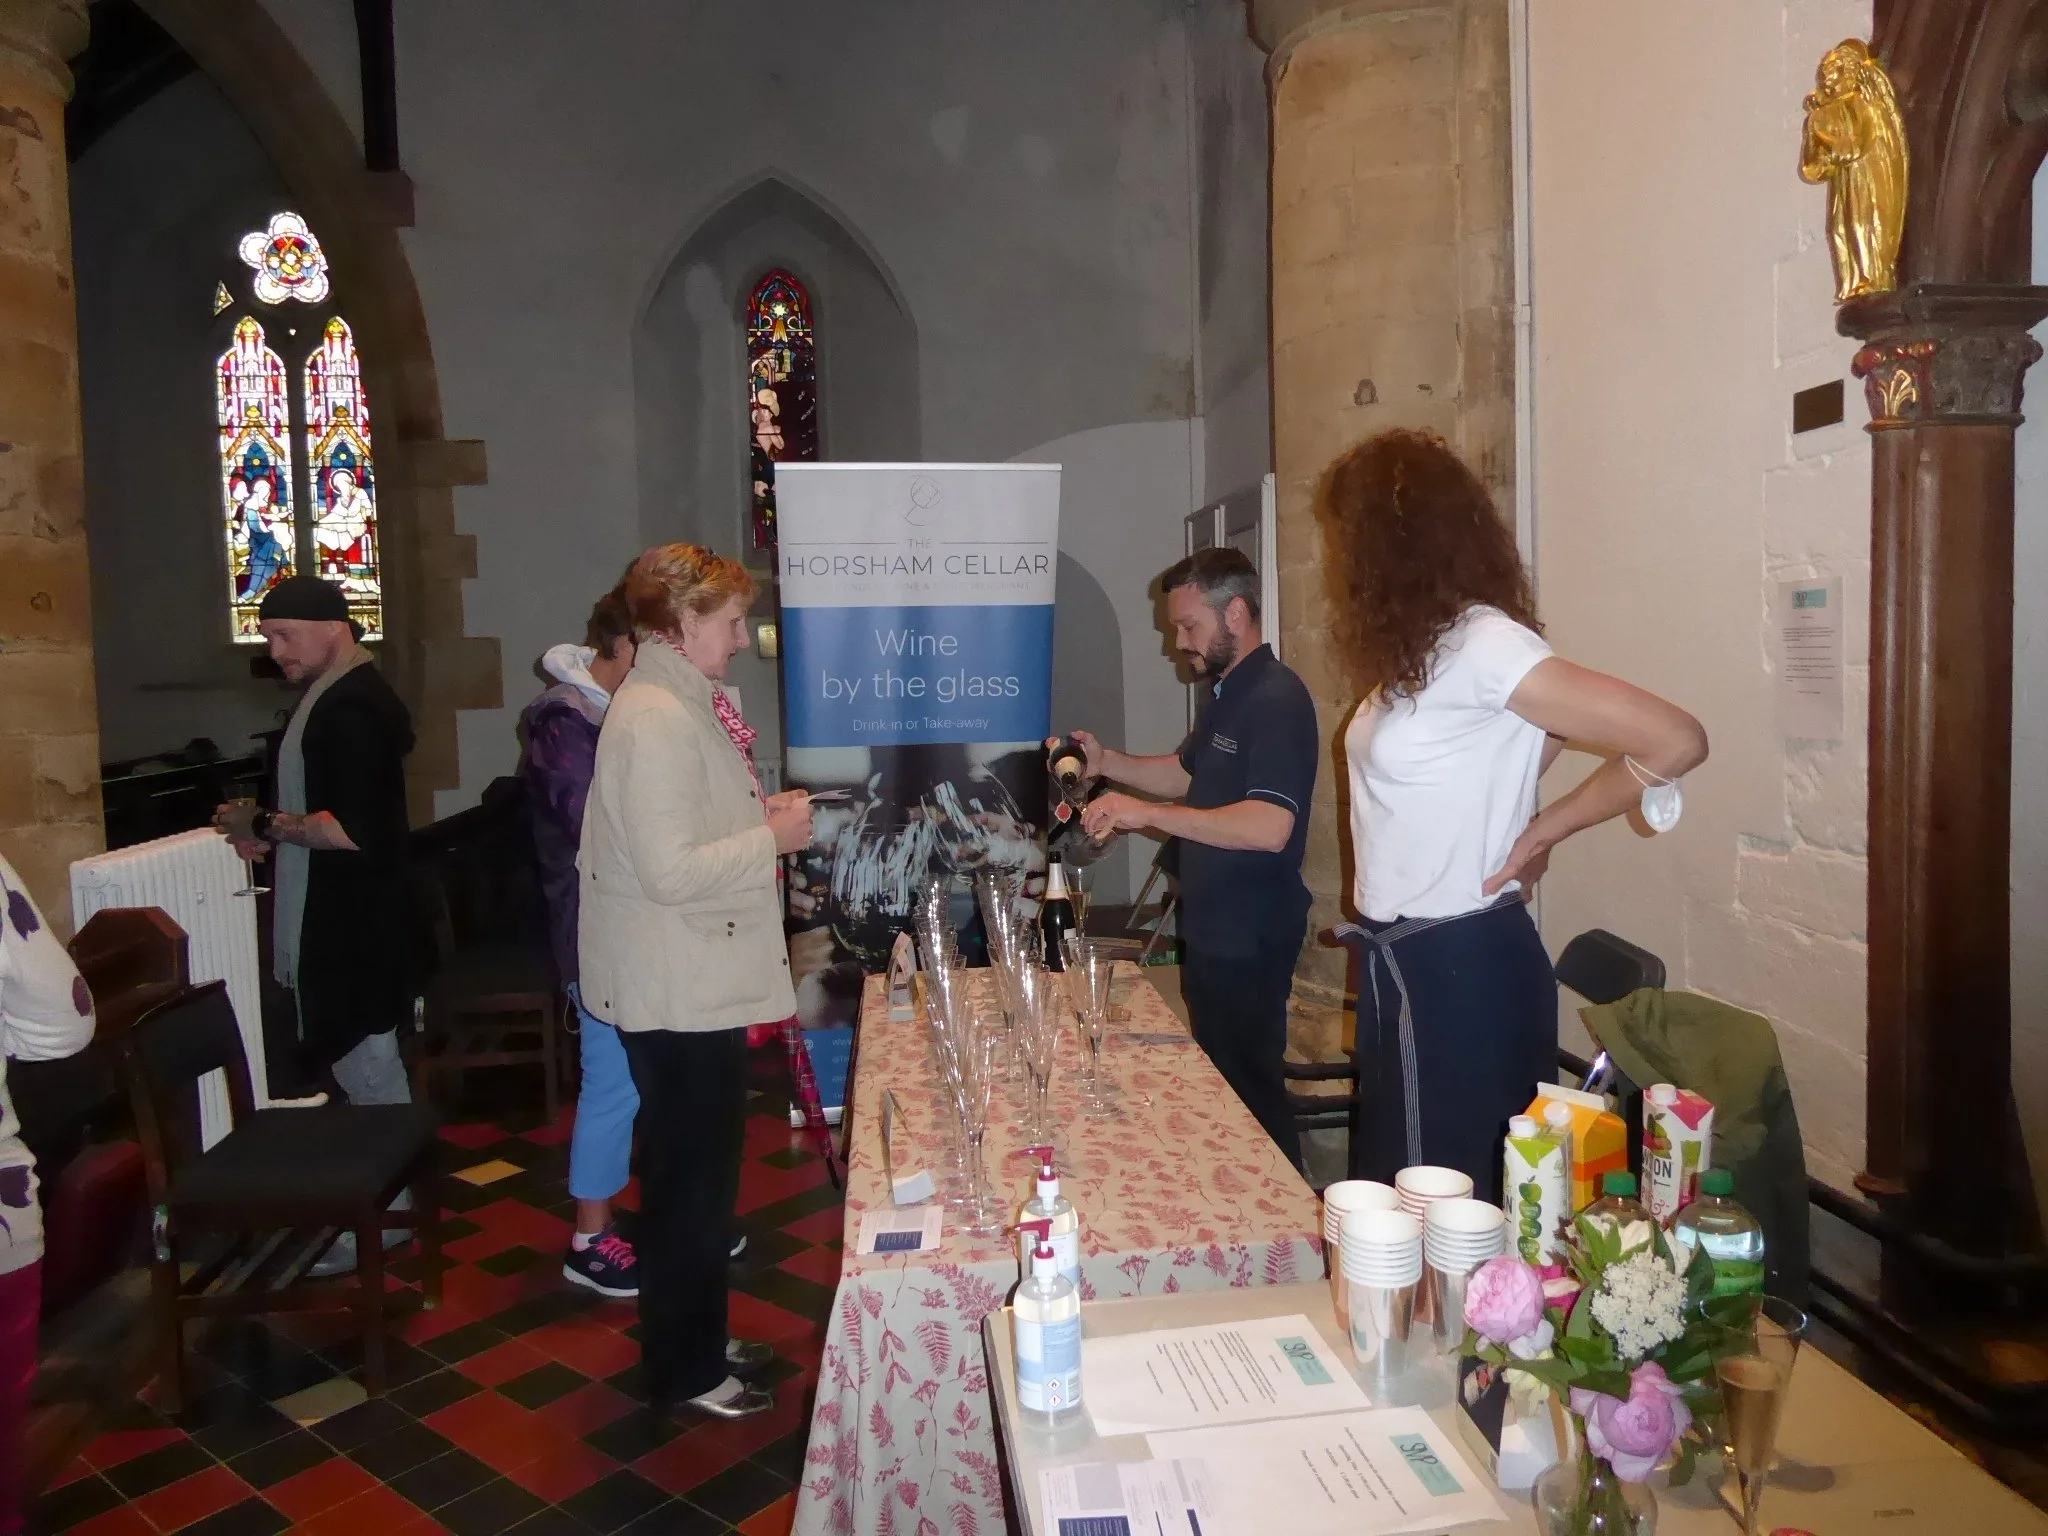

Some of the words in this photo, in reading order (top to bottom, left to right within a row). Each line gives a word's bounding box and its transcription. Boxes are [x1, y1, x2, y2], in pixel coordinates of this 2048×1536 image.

[908, 538, 933, 549] THE
[787, 554, 933, 576] HORSHAM
[944, 554, 1050, 575] CELLAR
[875, 629, 958, 656] Wine
[822, 669, 862, 705] by
[872, 669, 926, 697] the
[936, 669, 1020, 703] glass
[853, 718, 903, 731] Drink-in
[905, 720, 919, 730] or
[923, 716, 990, 731] Take-away
